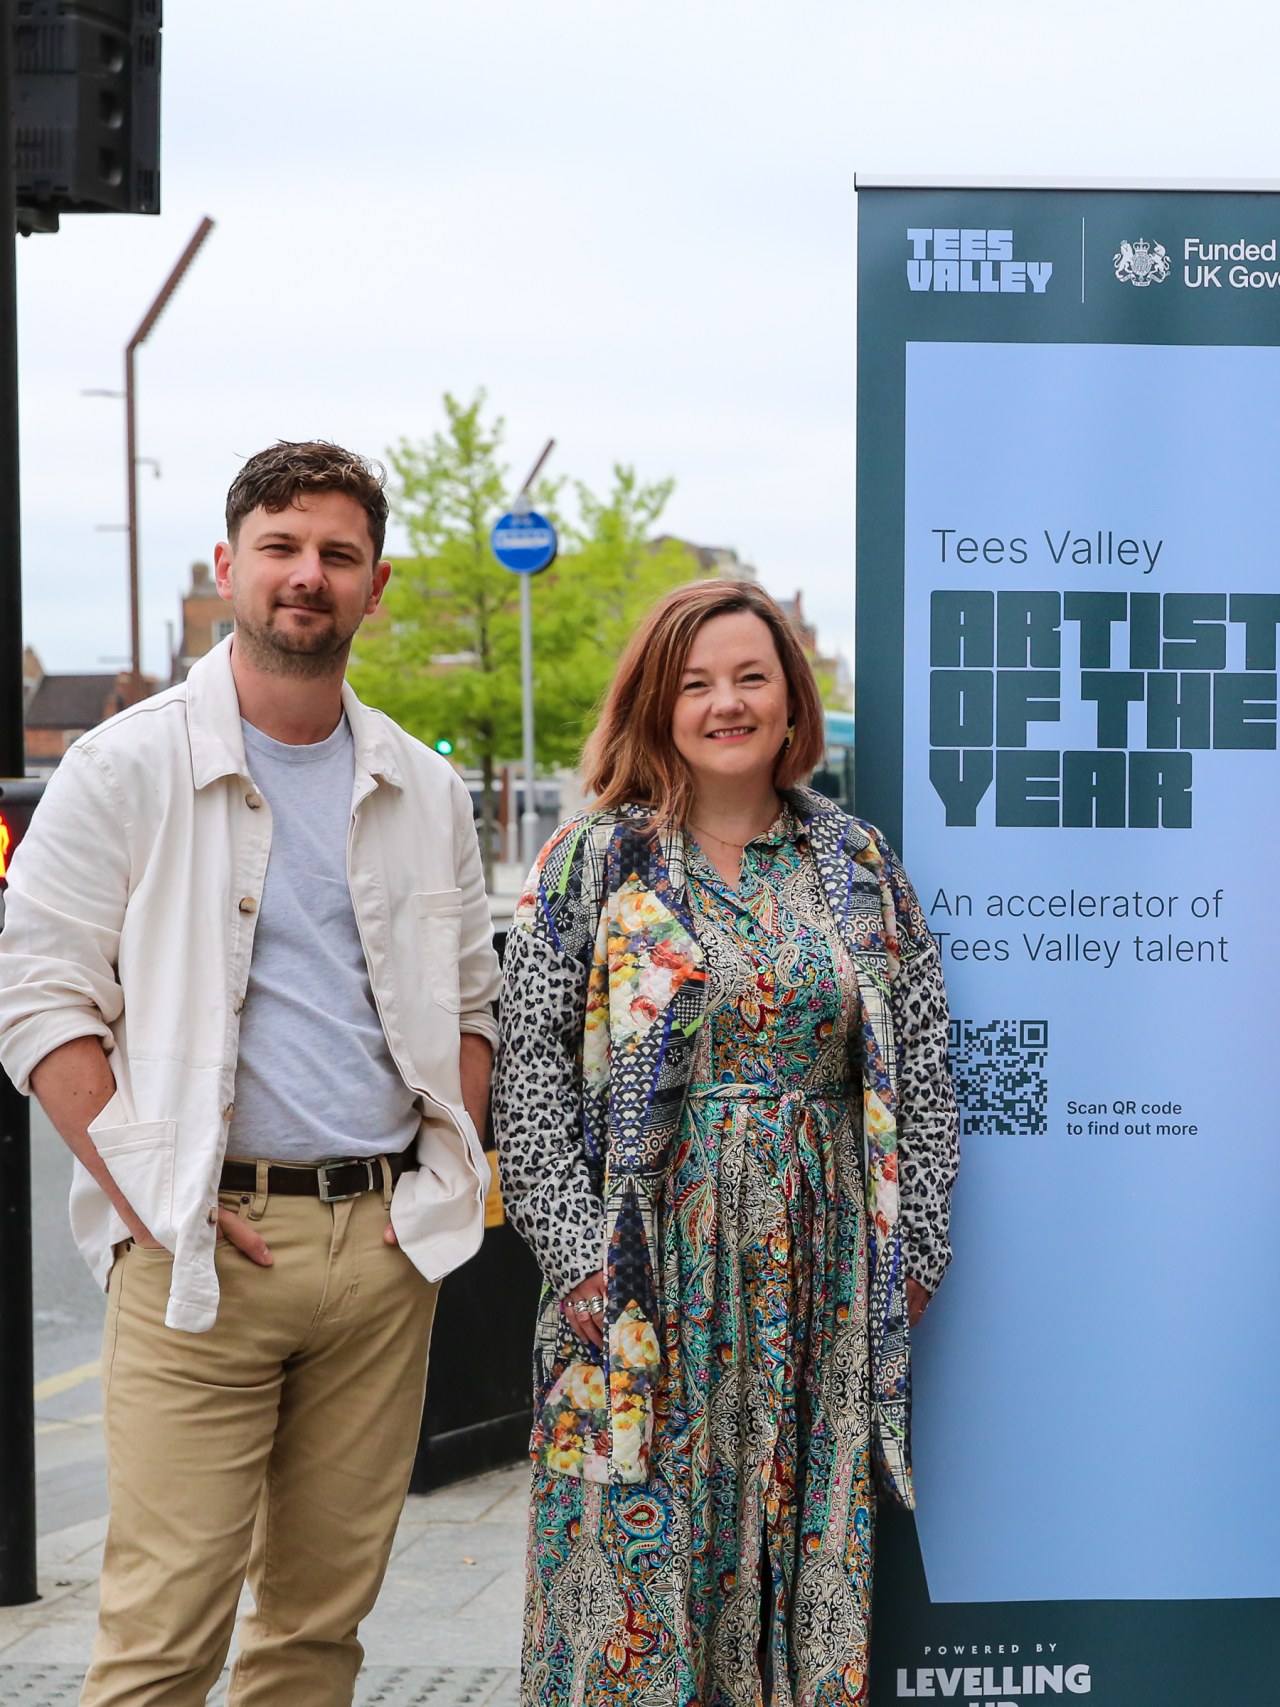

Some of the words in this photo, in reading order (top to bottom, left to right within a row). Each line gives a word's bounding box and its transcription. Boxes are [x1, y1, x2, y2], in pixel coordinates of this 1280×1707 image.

[907, 228, 1013, 261] TEES
[1184, 238, 1277, 262] Funded
[907, 260, 1053, 293] VALLEY
[1184, 265, 1223, 288] UK
[931, 529, 1028, 564] Tees
[1044, 529, 1164, 575] Valley
[929, 669, 1061, 748] OF
[1080, 671, 1278, 750] THE
[929, 749, 1193, 829] YEAR
[929, 887, 973, 917] An
[986, 888, 1179, 918] accelerator
[1190, 888, 1224, 918] of
[931, 932, 1010, 961] Tees
[1022, 933, 1121, 969] Valley
[1133, 933, 1229, 963] talent
[1066, 1100, 1108, 1115] Scan
[1112, 1100, 1137, 1116] QR
[1141, 1100, 1183, 1115] code
[1066, 1122, 1083, 1136] to
[1088, 1121, 1119, 1136] find
[1124, 1122, 1151, 1136] out
[1156, 1123, 1199, 1136] more
[924, 1644, 1020, 1656] POWERED
[1035, 1642, 1058, 1653] BY
[897, 1663, 1092, 1697] LEVELLING
